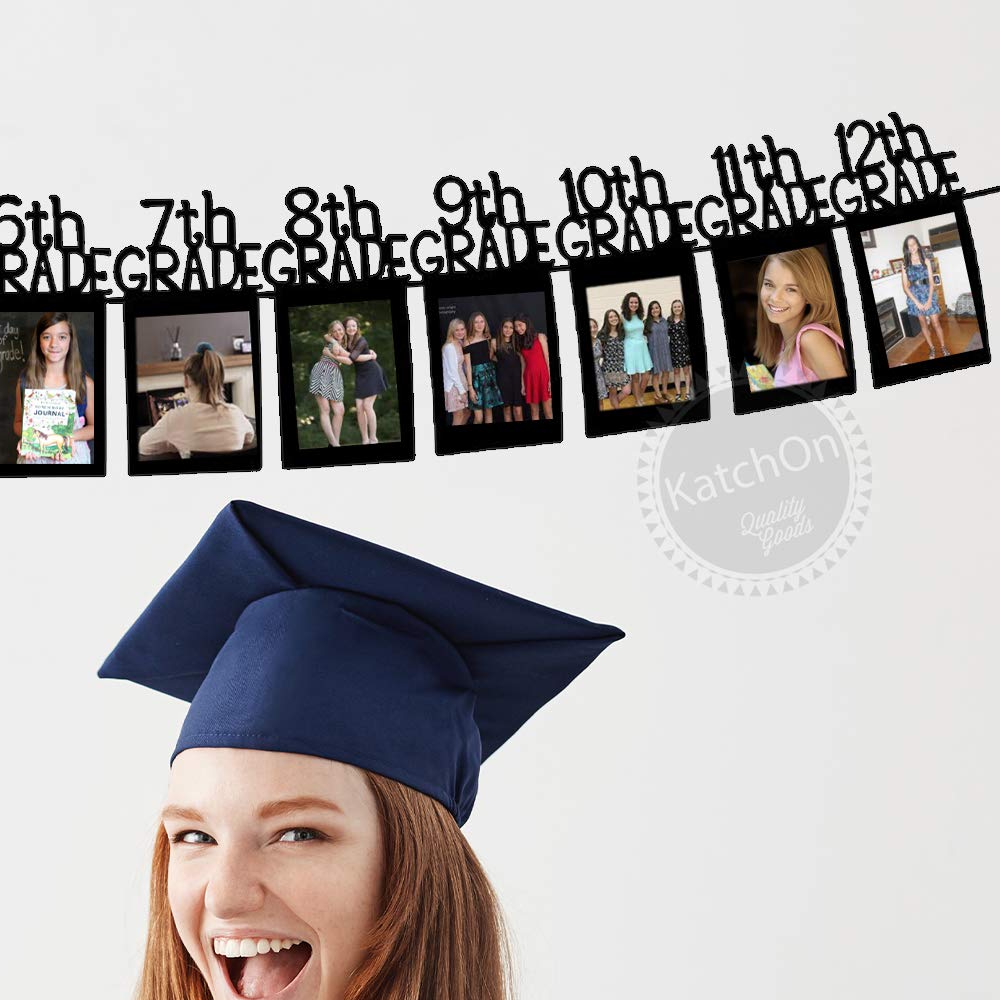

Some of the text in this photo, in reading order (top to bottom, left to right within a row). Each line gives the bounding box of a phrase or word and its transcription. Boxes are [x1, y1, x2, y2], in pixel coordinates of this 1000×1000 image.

[711, 134, 803, 196] 11th
[835, 112, 933, 175] 12th
[433, 170, 526, 228] 9th
[559, 156, 668, 215] 10th
[695, 175, 835, 239] GRADE
[830, 151, 966, 215] GRADE
[140, 190, 236, 248] 7th
[284, 184, 382, 242] 8th
[555, 201, 698, 260] GRADE
[113, 243, 263, 293] GRADE
[262, 234, 411, 286] GRADE
[410, 220, 555, 276] GRADE
[4, 322, 19, 340] day
